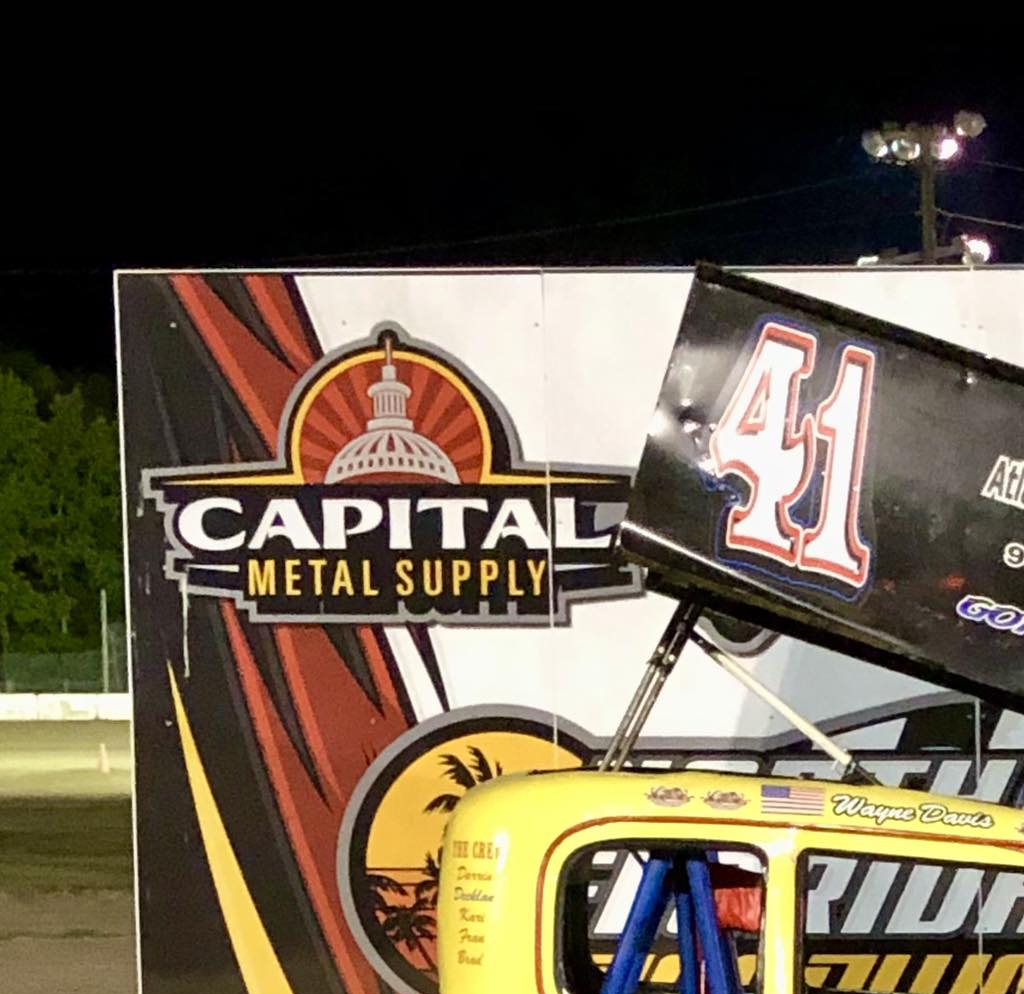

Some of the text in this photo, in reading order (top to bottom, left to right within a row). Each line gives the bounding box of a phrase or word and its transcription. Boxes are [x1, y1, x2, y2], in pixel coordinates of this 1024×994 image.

[709, 321, 876, 588] 41
[178, 496, 615, 551] CAPITAL
[247, 558, 548, 597] METAL SUPPLY
[830, 793, 995, 829] Wayne Davis
